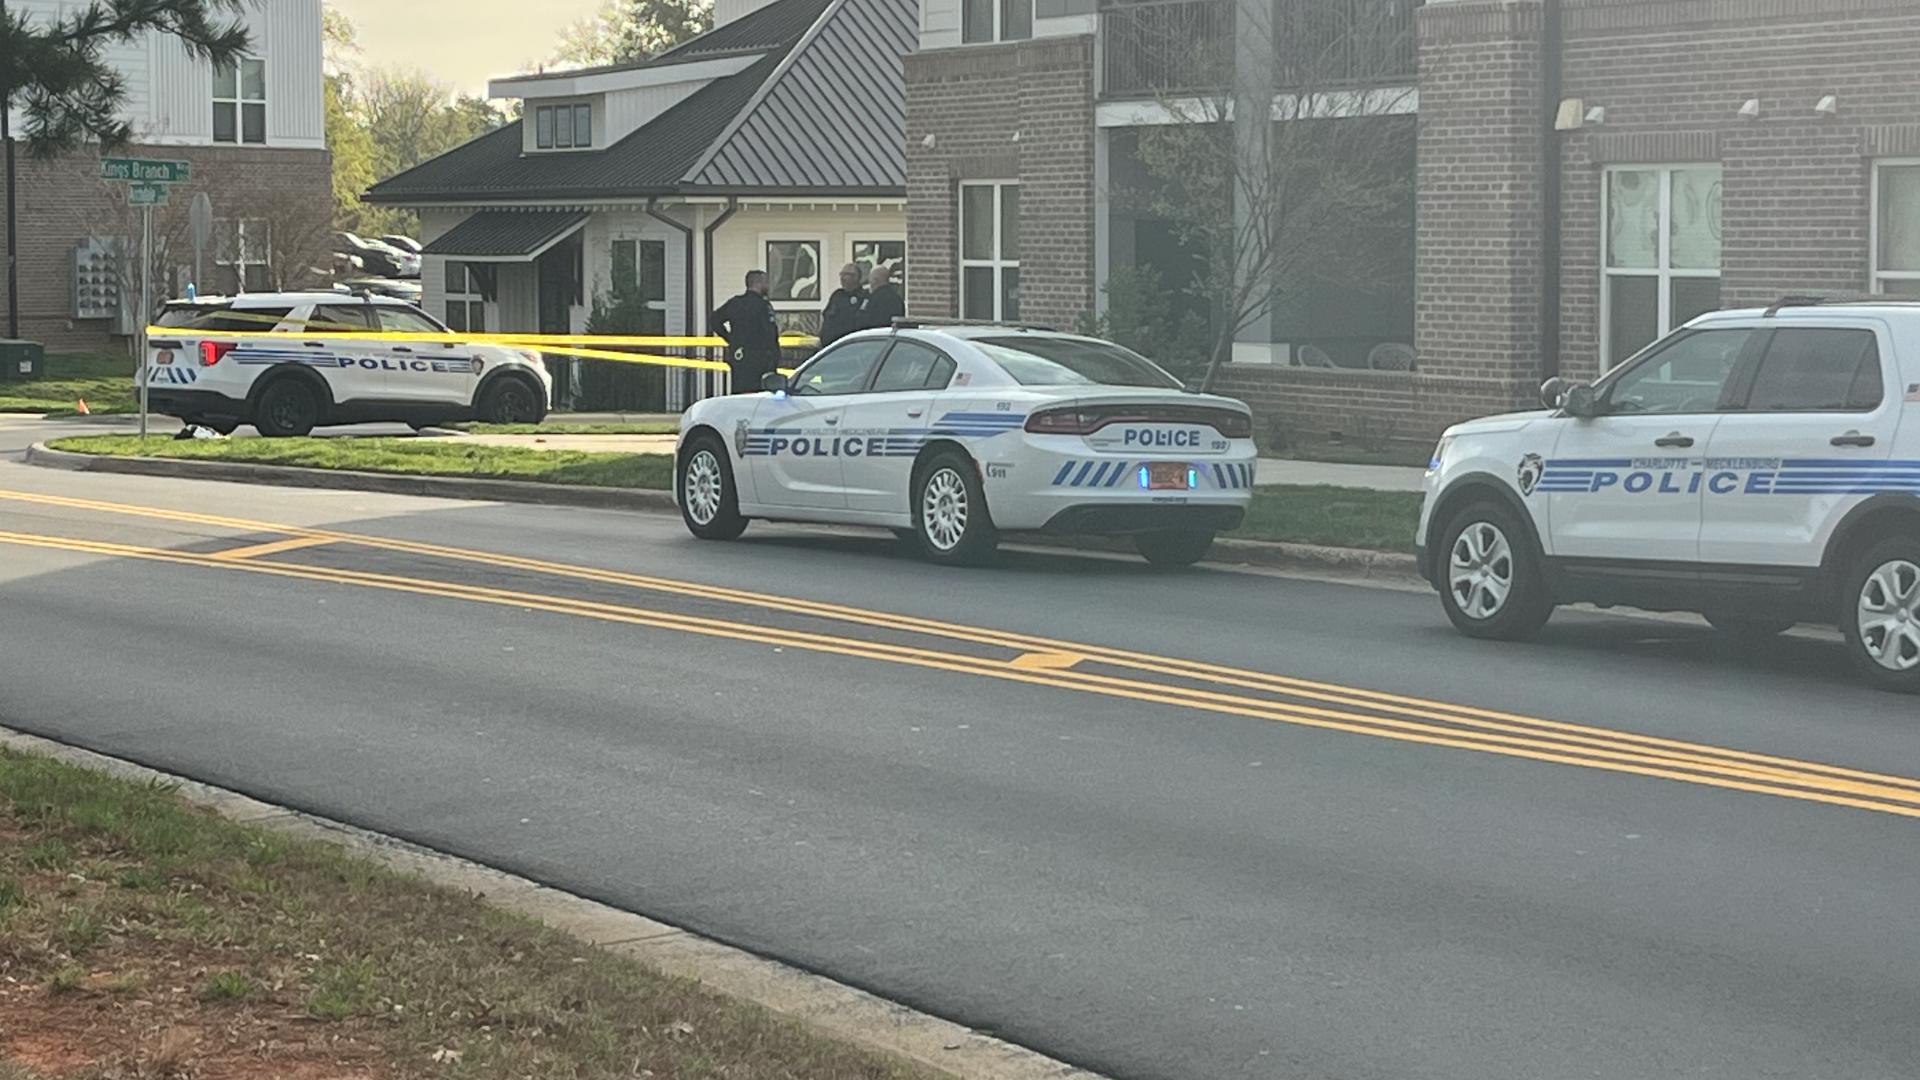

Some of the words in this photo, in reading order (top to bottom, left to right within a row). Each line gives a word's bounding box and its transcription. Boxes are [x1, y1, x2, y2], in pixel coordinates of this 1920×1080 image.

[101, 161, 129, 178] Kings
[132, 161, 170, 179] Branch
[338, 357, 449, 373] POLICE
[1124, 429, 1201, 446] POLICE
[770, 437, 886, 457] POLICE
[1590, 472, 1776, 494] POLICE
